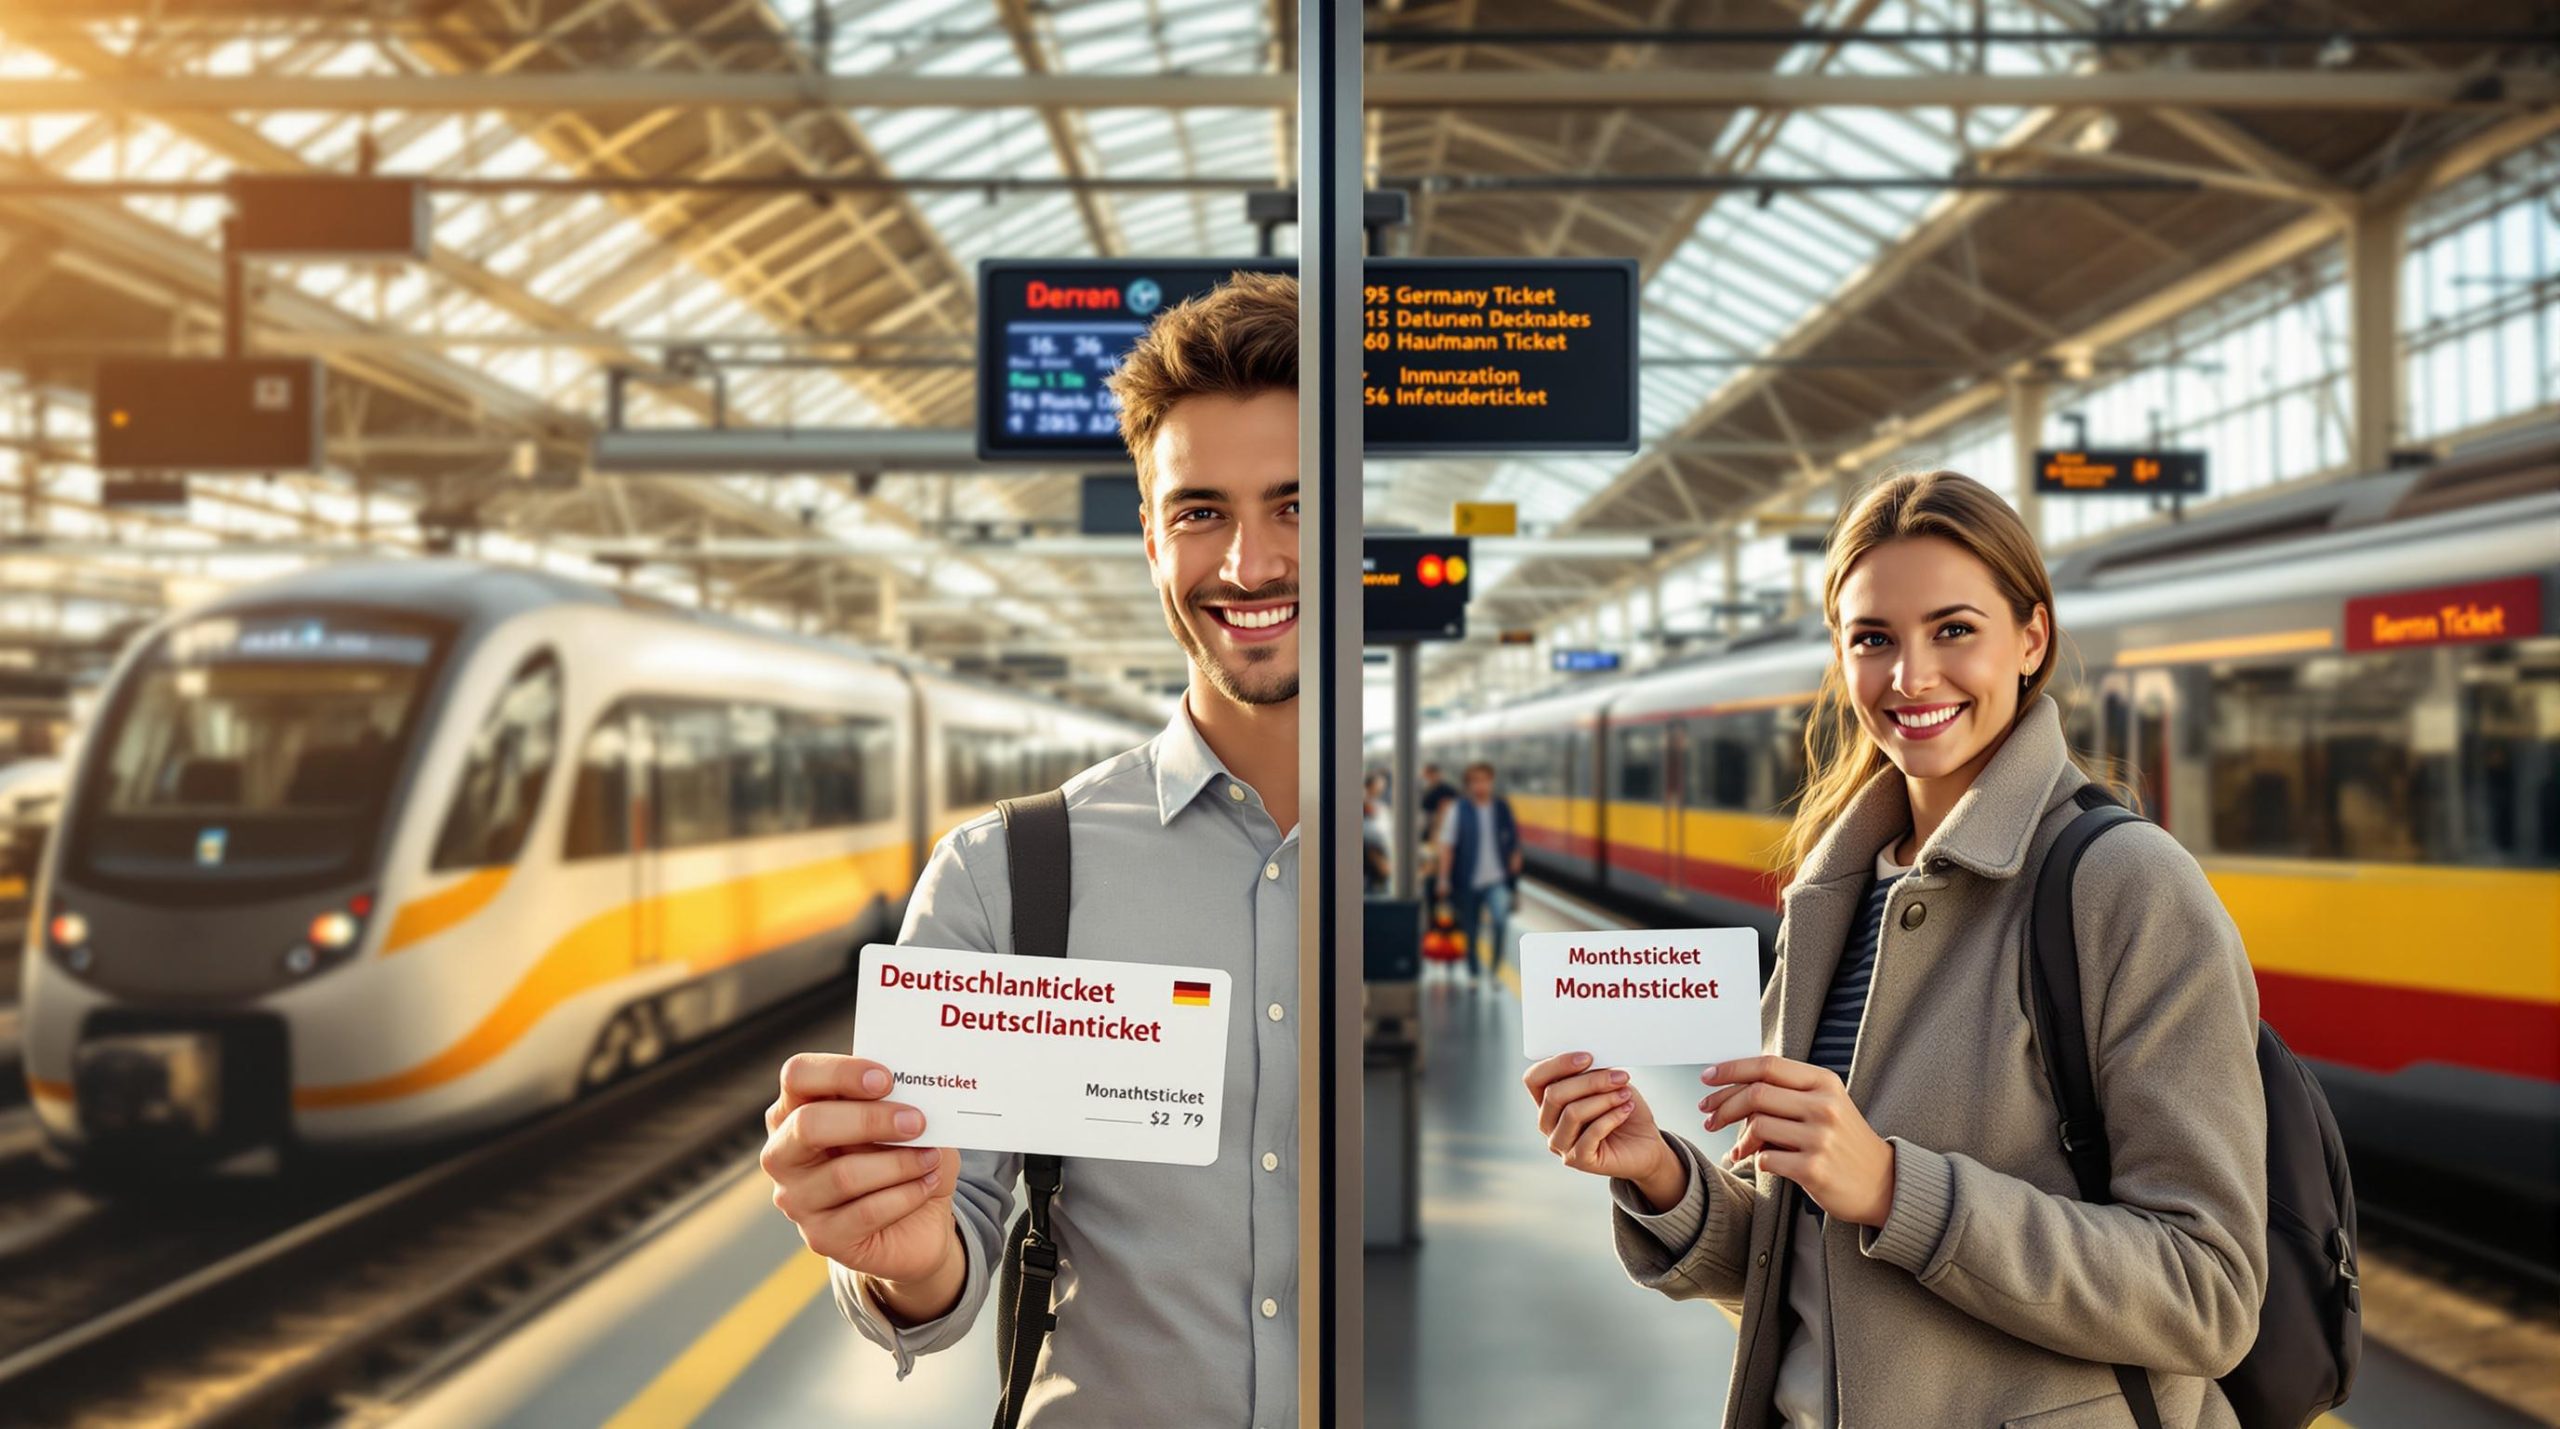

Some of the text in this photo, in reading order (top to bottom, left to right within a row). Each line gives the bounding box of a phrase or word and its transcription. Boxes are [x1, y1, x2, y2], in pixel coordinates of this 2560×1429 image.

[1365, 286, 1555, 308] 95 Germany Ticket
[1366, 310, 1388, 327] 15
[1364, 332, 1390, 350] 60
[1504, 332, 1567, 350] Ticket
[1365, 387, 1389, 405] 56
[1569, 947, 1701, 965] Monthsticket
[1556, 977, 1718, 998] Monahsticket
[894, 1072, 976, 1089] Montsticket
[1086, 1083, 1204, 1104] Monathtsticket
[1150, 1111, 1203, 1127] $2 79
